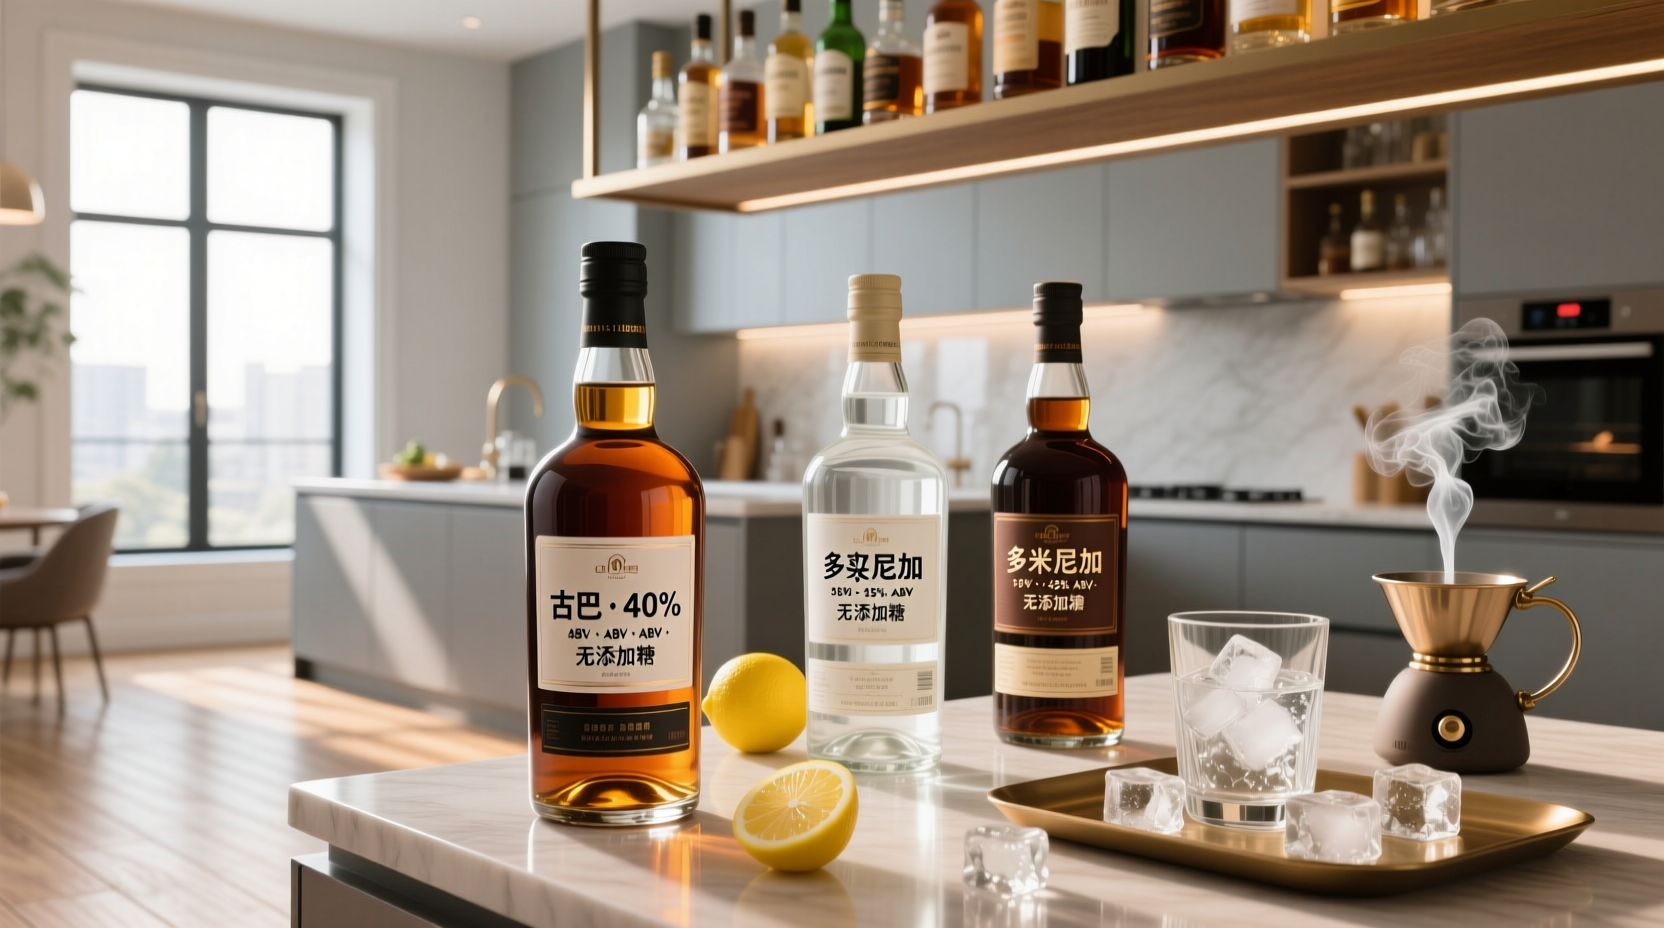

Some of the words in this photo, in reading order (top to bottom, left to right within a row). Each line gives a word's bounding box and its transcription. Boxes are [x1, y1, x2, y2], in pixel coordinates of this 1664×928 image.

[1007, 545, 1102, 575] 多米尼加
[604, 628, 627, 639] ABV
[639, 627, 662, 639] ABV
[576, 644, 655, 666] 无添加糖
